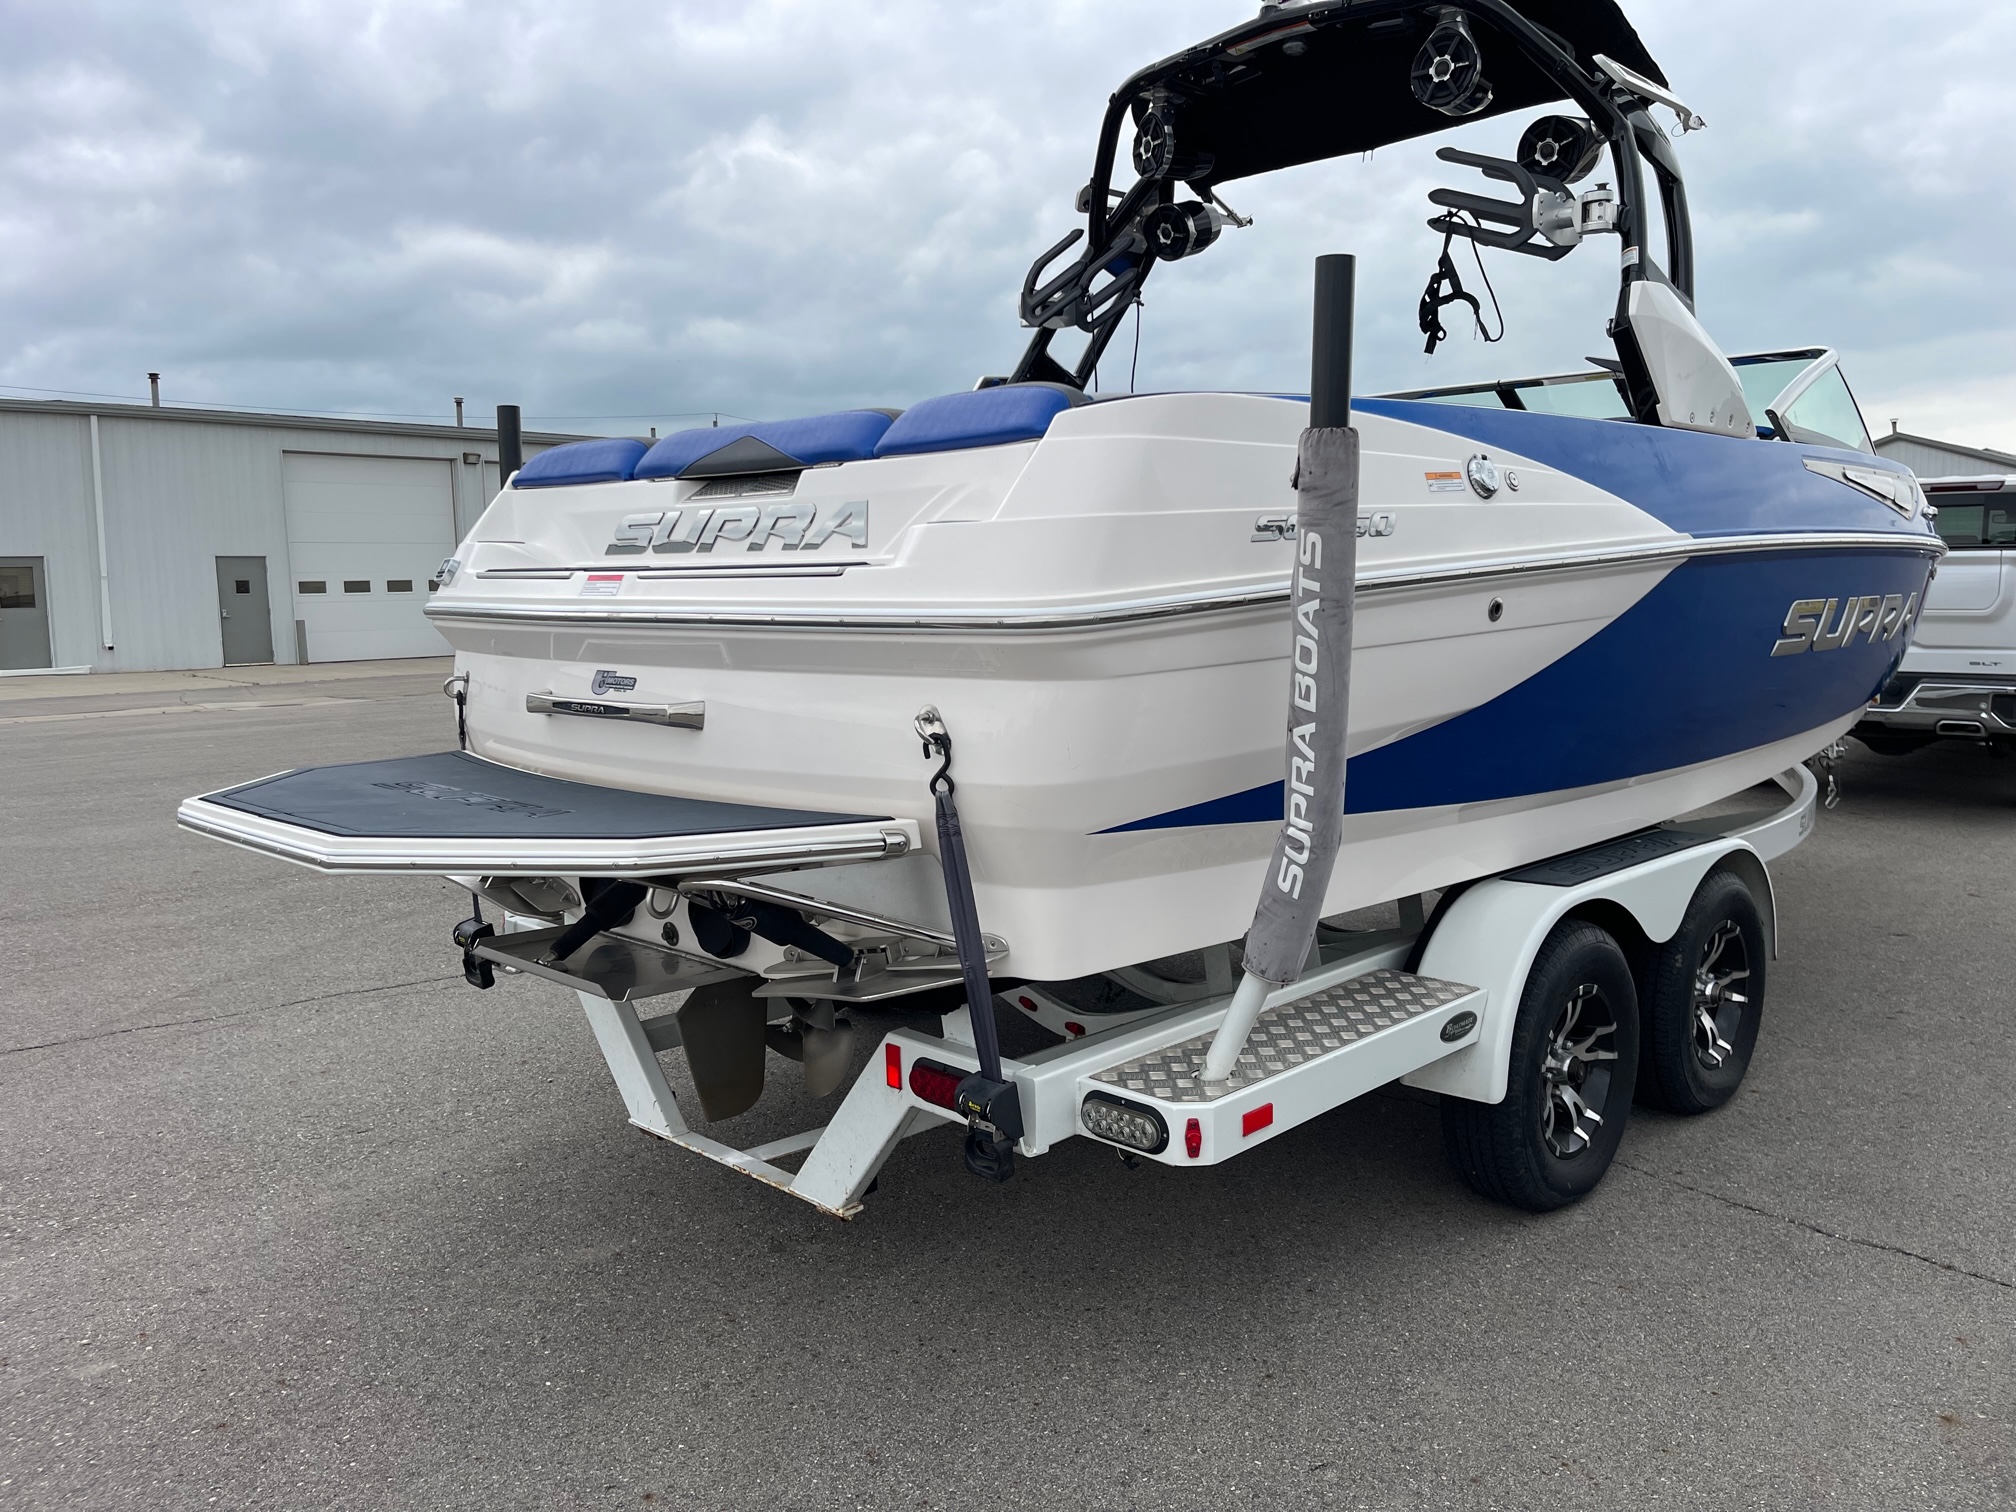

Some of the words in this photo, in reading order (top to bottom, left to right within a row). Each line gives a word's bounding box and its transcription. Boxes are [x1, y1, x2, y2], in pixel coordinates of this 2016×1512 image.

[605, 500, 869, 556] SUPRA
[1294, 528, 1323, 713] BOATS
[1769, 592, 1918, 657] SUPRA
[571, 703, 605, 714] SUPRA
[607, 677, 635, 685] MOTORS
[1277, 722, 1317, 900] SUPRA
